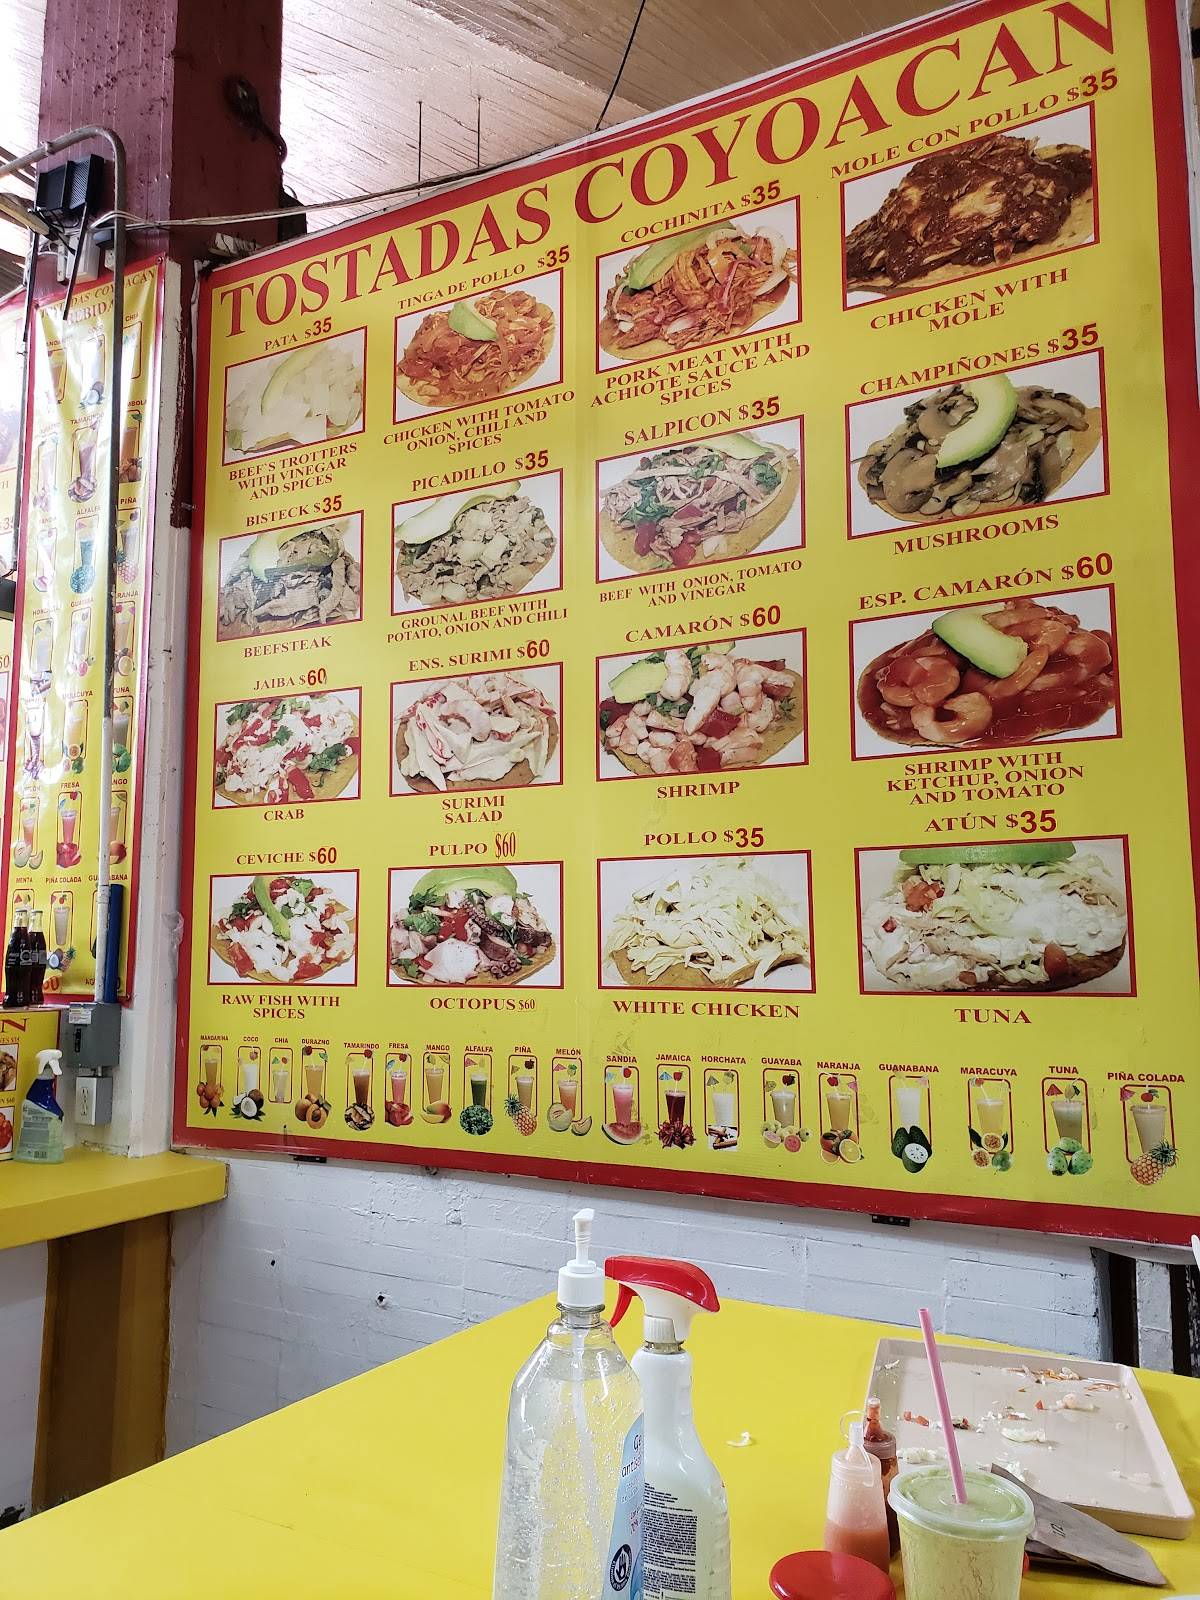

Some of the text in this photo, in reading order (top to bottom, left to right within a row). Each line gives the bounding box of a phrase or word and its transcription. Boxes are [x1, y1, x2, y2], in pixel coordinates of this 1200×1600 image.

[830, 67, 1119, 179] MOLE CON POLLO $35
[220, 0, 1114, 338] TOSTADAS COYOACAN
[621, 180, 781, 243] COCHINITA $35
[398, 245, 570, 310] TINGA DE POLLO $35
[870, 267, 1070, 330] CHICKEN WITH
[928, 301, 1005, 332] MOLE
[264, 316, 332, 351] PATA $35
[606, 332, 792, 389] PORK MEAT WITH
[860, 322, 1099, 396] CHAMPIÑONES $35
[590, 344, 810, 408] ACHIOTE SAUCE AND
[660, 378, 732, 406] SPICES
[383, 390, 575, 446] CHICKEN WITH TOMATO
[624, 395, 780, 446] SALPICON $35
[407, 410, 547, 453] ONION, CHILI AND
[448, 433, 502, 455] SPICES
[280, 442, 357, 469] TROTTERS
[238, 457, 347, 490] WITH VINEGAR
[412, 450, 549, 491] PICADILLO $35
[250, 473, 333, 501] AND SPICES
[246, 495, 342, 527] BISTECK $35
[892, 514, 1059, 556] MUSHROOMS
[600, 559, 803, 603] BEEF WITH ONION, TOMATO
[859, 552, 1113, 611] ESP. CAMARÓN $60
[648, 582, 746, 608] AND VINEGAR
[387, 608, 568, 644] POTATO, ONION AND CHILI
[401, 599, 547, 629] GROUNAL BEEF WITH
[625, 605, 781, 643] CAMARÓN $60
[244, 636, 332, 658] BEEFSTEAK
[409, 639, 550, 672] ENS. SURIMI $60
[253, 667, 327, 691] JAIBA $60
[905, 751, 1062, 776] SHRIMP WITH
[60, 781, 80, 789] FRESA
[657, 781, 740, 799] SHRIMP
[887, 765, 1084, 792] KETCHUP, ONION
[442, 795, 505, 810] SURIMI
[910, 783, 1065, 806] AND TOMATO
[264, 808, 305, 822] CRAB
[444, 810, 503, 825] SALAD
[924, 809, 1057, 834] ATÚN $35
[428, 832, 516, 859] PULPO $60
[644, 827, 764, 848] POLLO $35
[236, 846, 337, 865] CEVICHE $60
[222, 994, 341, 1007] RAW FISH WITH
[429, 998, 535, 1011] OCTOPUS $60
[613, 1000, 800, 1018] WHITE CHICKEN
[253, 1008, 305, 1019] SPICES
[954, 1008, 1032, 1024] TUNA
[343, 1042, 380, 1050] TAMARINDO
[465, 1045, 494, 1053] ALFALFA
[555, 1048, 581, 1056] MELÓN
[655, 1053, 692, 1062] JAMAICA
[606, 1055, 638, 1064] SANDIA
[701, 1055, 747, 1065] HORCHATA
[761, 1057, 802, 1067] GUAYABA
[817, 1061, 861, 1071] NARANJA
[878, 1063, 939, 1073] GUANABANA
[960, 1066, 1017, 1077] MARACUYA
[1048, 1065, 1079, 1075] TUNA
[1107, 1071, 1185, 1083] PIÑA COLADA
